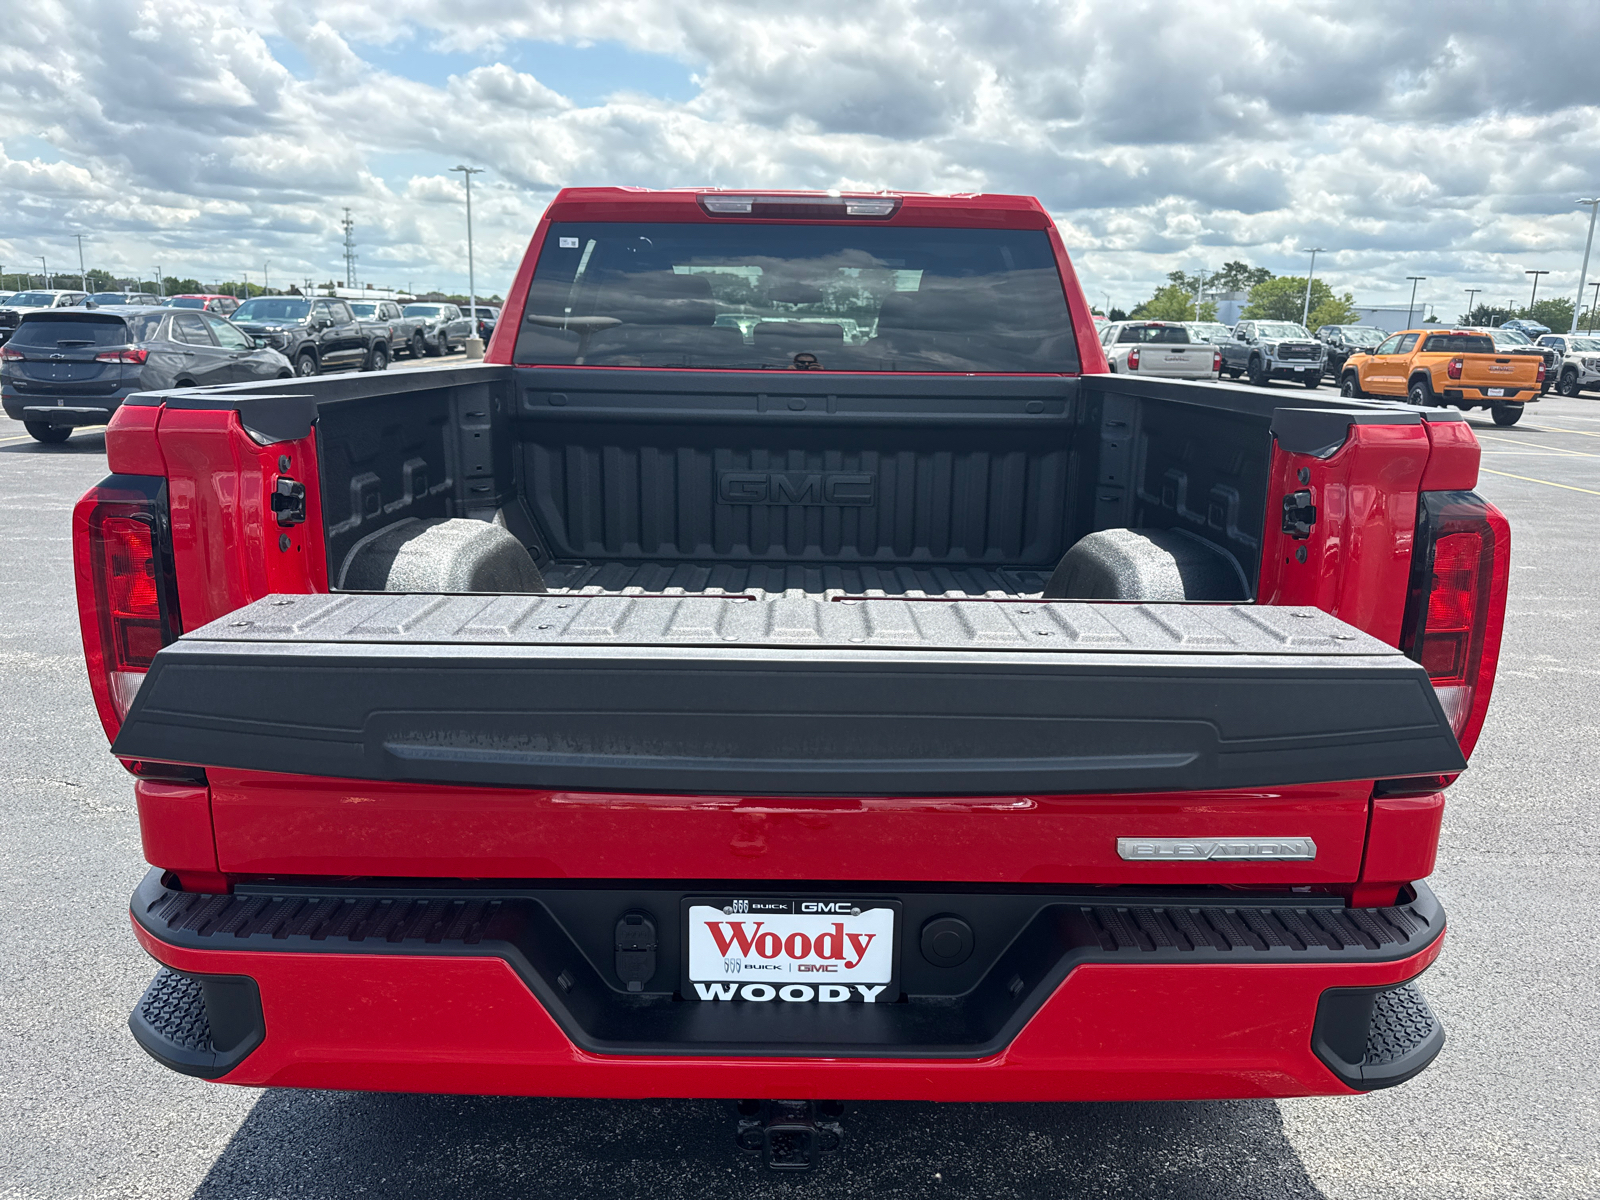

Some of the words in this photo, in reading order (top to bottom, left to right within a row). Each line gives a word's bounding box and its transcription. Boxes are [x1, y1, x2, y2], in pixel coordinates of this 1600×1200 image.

[720, 473, 872, 504] GMC
[1132, 843, 1303, 856] ELEVATION
[801, 902, 852, 913] GMC
[704, 921, 876, 969] Woody
[744, 963, 783, 971] BUICK
[797, 964, 839, 973] GMC
[693, 983, 887, 1003] WOODY
